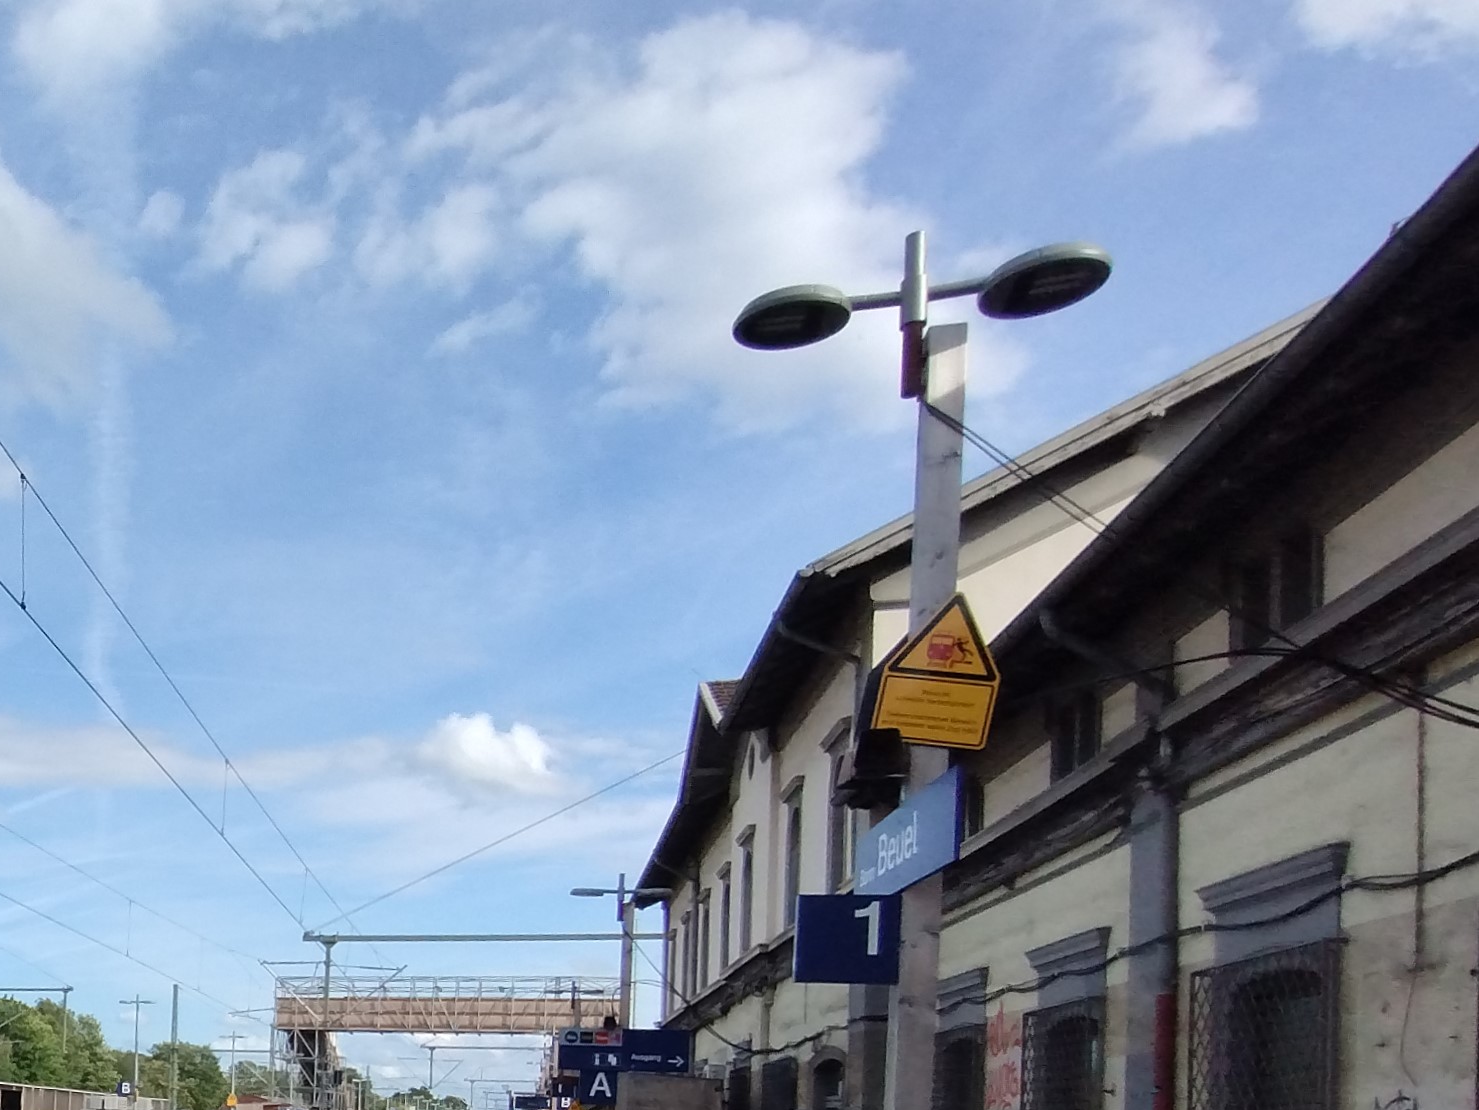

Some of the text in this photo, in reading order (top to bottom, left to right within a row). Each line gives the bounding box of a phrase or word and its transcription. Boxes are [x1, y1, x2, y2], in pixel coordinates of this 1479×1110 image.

[877, 810, 918, 877] Beuel
[854, 901, 881, 956] 1
[630, 1053, 662, 1063] Ausgang
[122, 1082, 131, 1093] B
[589, 1072, 612, 1097] A
[560, 1097, 571, 1108] B
